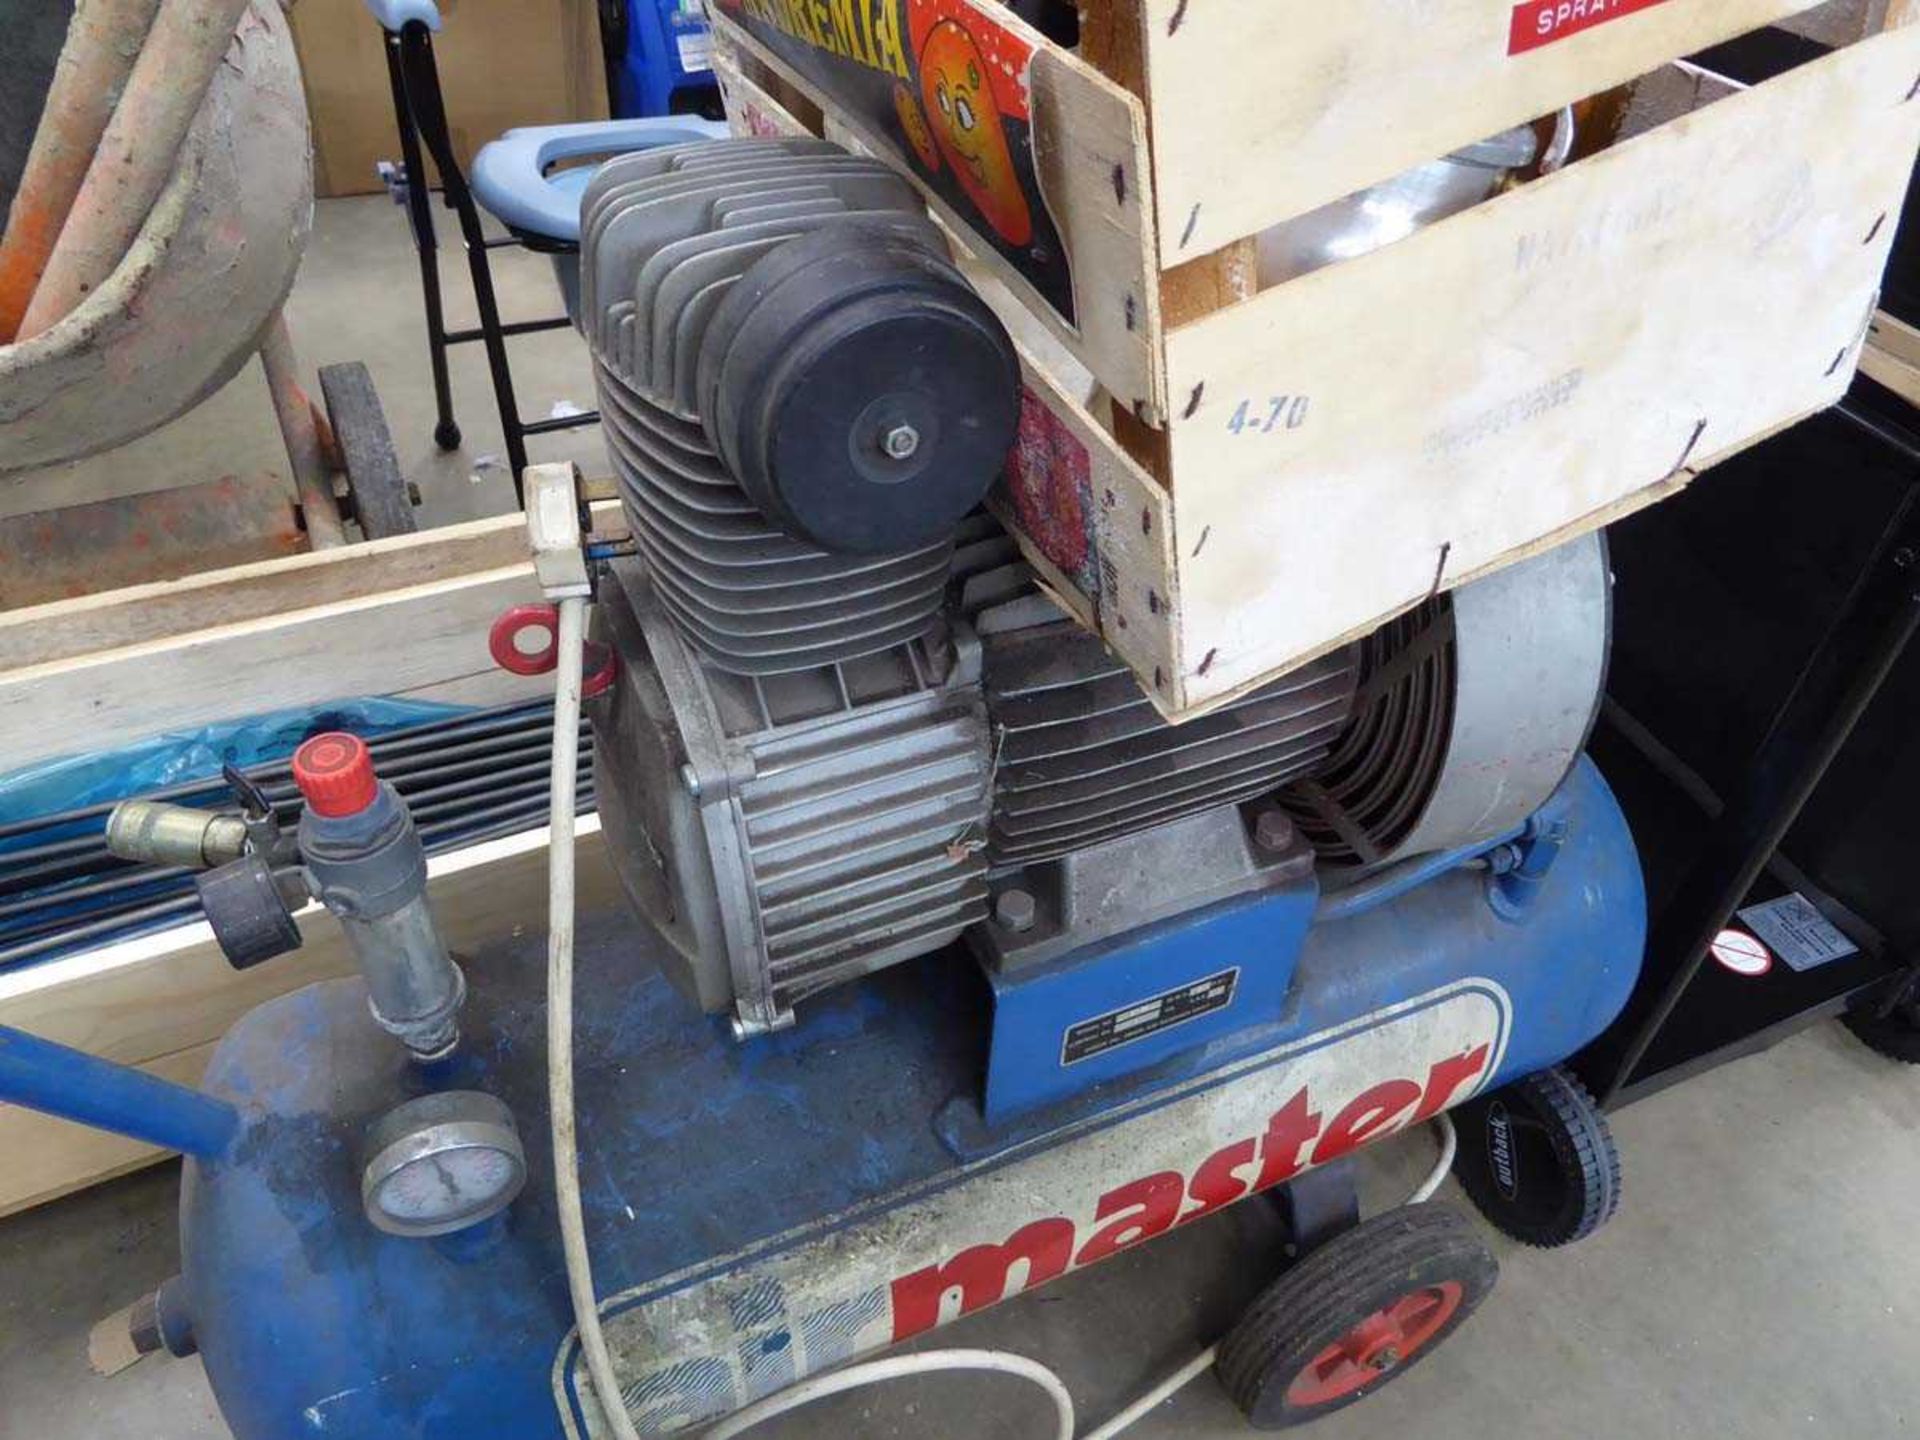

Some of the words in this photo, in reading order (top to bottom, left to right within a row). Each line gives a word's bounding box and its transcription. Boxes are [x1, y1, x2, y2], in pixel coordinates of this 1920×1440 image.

[1536, 0, 1617, 34] SPRA
[1489, 1115, 1513, 1187] outback
[890, 1042, 1491, 1345] master
